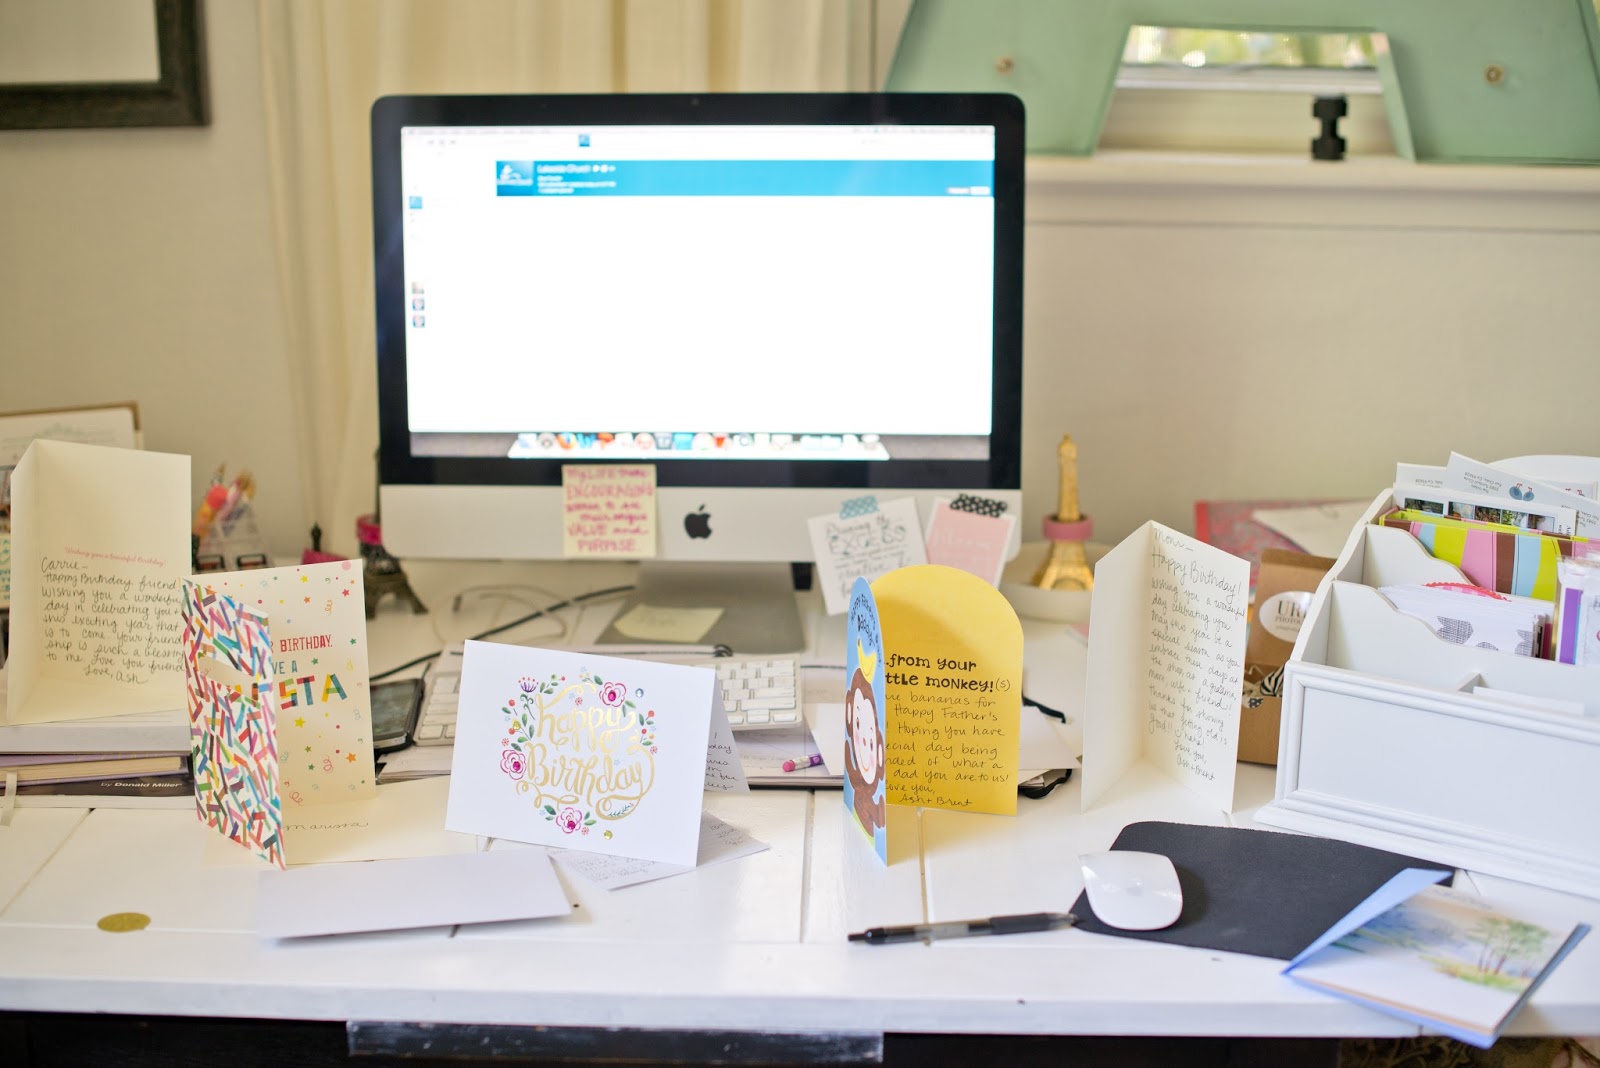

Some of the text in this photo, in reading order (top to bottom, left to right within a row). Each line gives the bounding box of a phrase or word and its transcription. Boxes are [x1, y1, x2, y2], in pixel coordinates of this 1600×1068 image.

[1151, 545, 1189, 586] Happy
[80, 574, 132, 591] Birthday
[42, 586, 86, 600] Wishing
[92, 589, 113, 604] you
[119, 592, 129, 601] a
[1183, 588, 1200, 606] you
[44, 602, 70, 617] day
[74, 602, 84, 613] in
[91, 602, 149, 618] celebrating
[154, 607, 172, 621] you
[59, 628, 71, 640] to
[156, 618, 180, 632] that
[47, 651, 58, 662] to
[122, 655, 145, 670] you
[132, 648, 142, 658] a
[272, 660, 298, 676] VE A
[936, 658, 977, 672] your
[278, 673, 348, 710] STA
[909, 691, 971, 706] bananas
[974, 697, 997, 710] for
[893, 703, 999, 724] Happy Father's
[898, 720, 940, 741] Hoping
[972, 725, 1006, 737] have
[885, 741, 999, 761] ecial day being
[885, 756, 1004, 771] nded of what a
[522, 740, 655, 806] Birthday
[893, 768, 918, 780] dad
[924, 770, 949, 783] you
[954, 773, 978, 783] are
[978, 773, 990, 783] to
[898, 794, 927, 806] Ash
[936, 796, 973, 808] Brent
